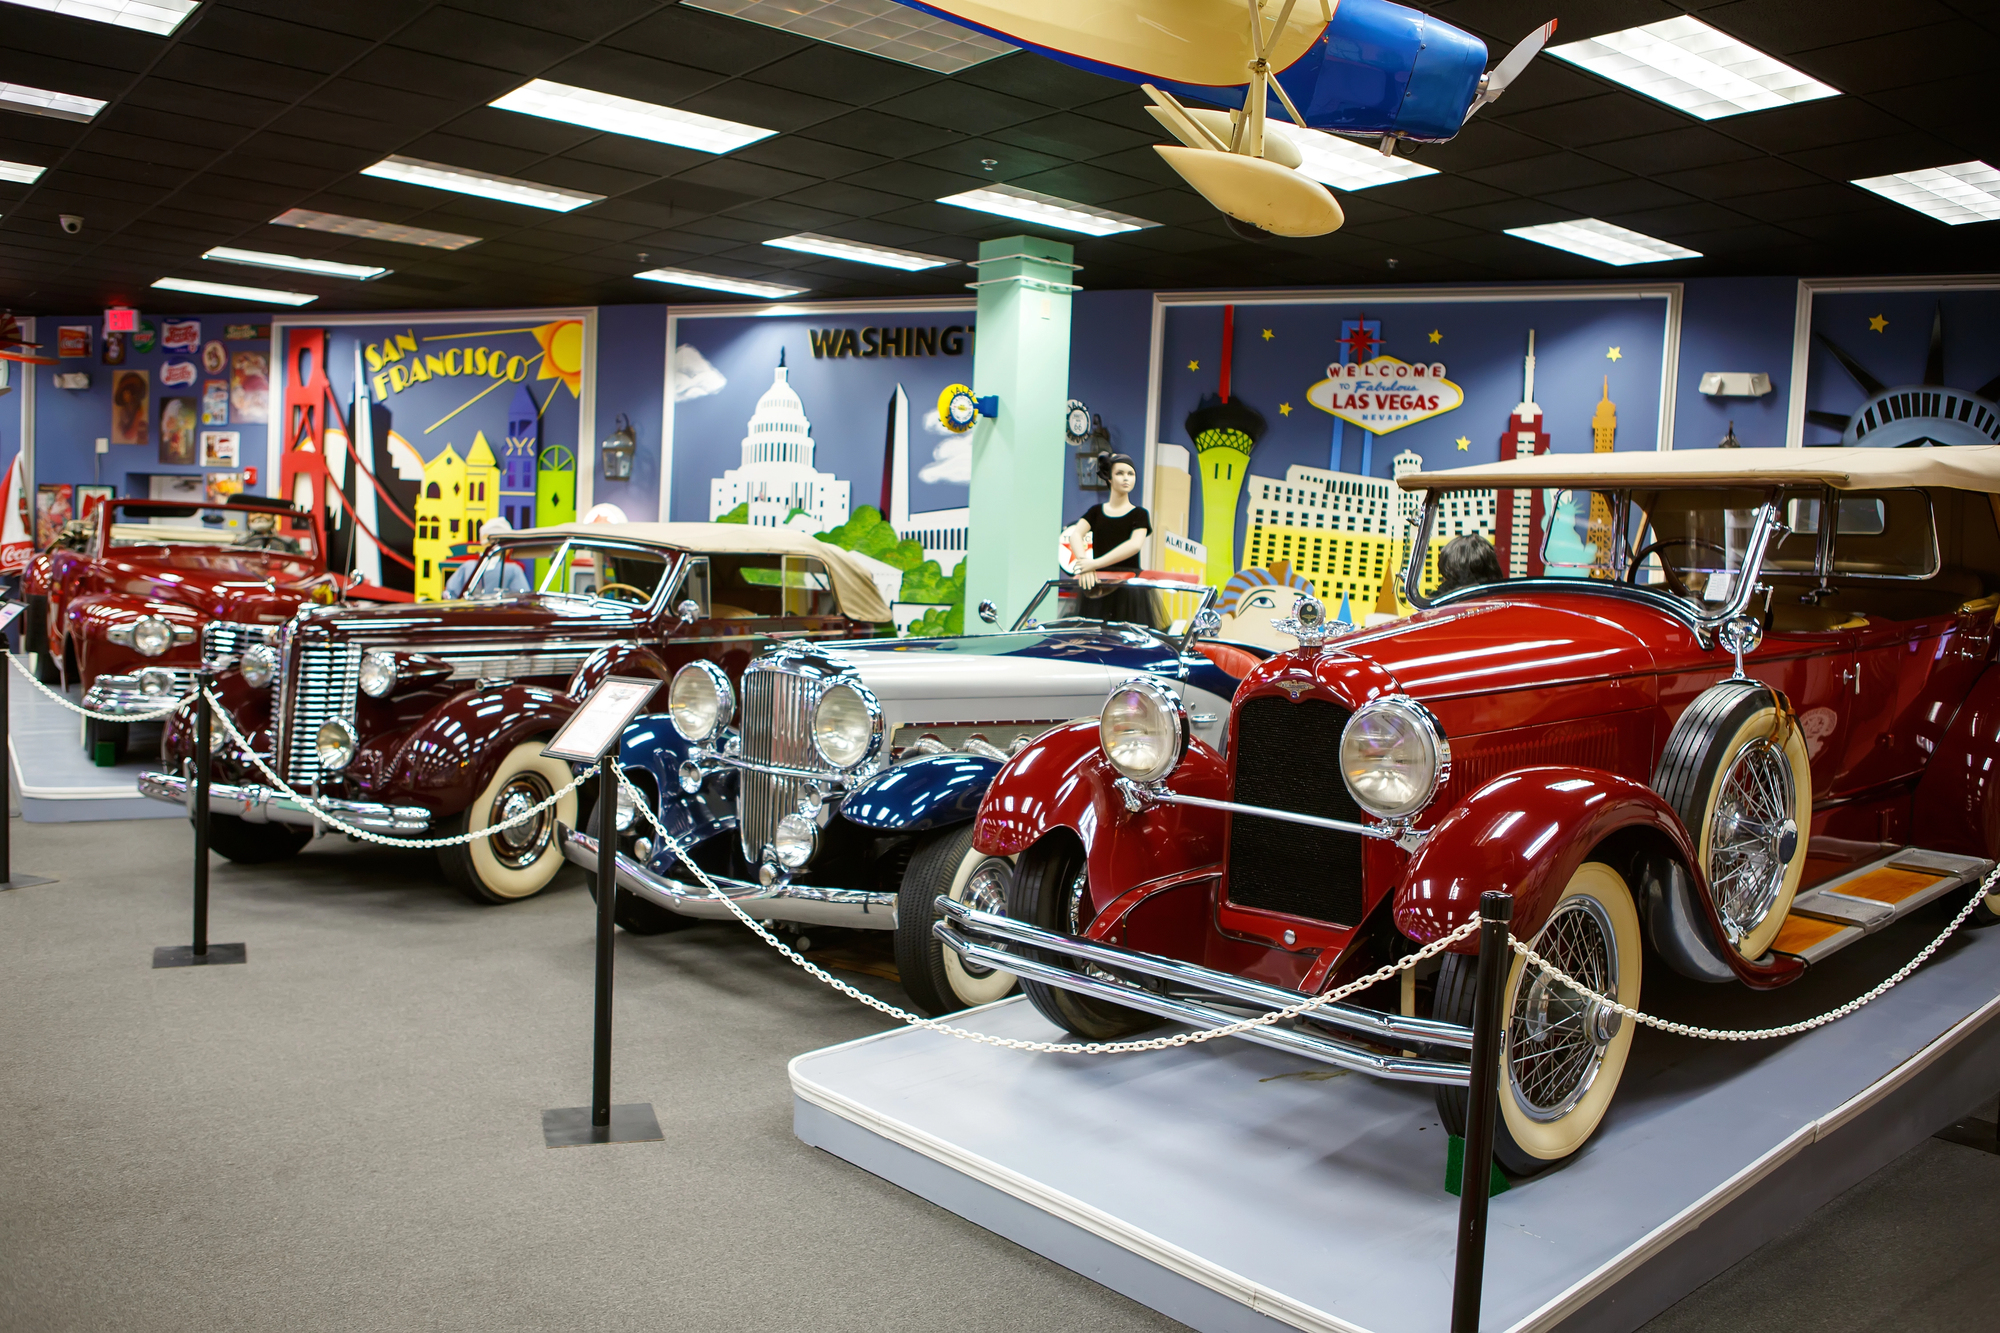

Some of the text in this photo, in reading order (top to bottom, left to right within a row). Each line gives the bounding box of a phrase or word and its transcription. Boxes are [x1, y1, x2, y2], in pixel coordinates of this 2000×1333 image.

[364, 328, 418, 373] SAN
[372, 346, 528, 402] FRANCISCO
[1328, 365, 1442, 378] WELCOME
[1354, 380, 1419, 393] Fabulous
[1332, 393, 1439, 411] LAS VEGAS
[1185, 542, 1198, 555] BAY
